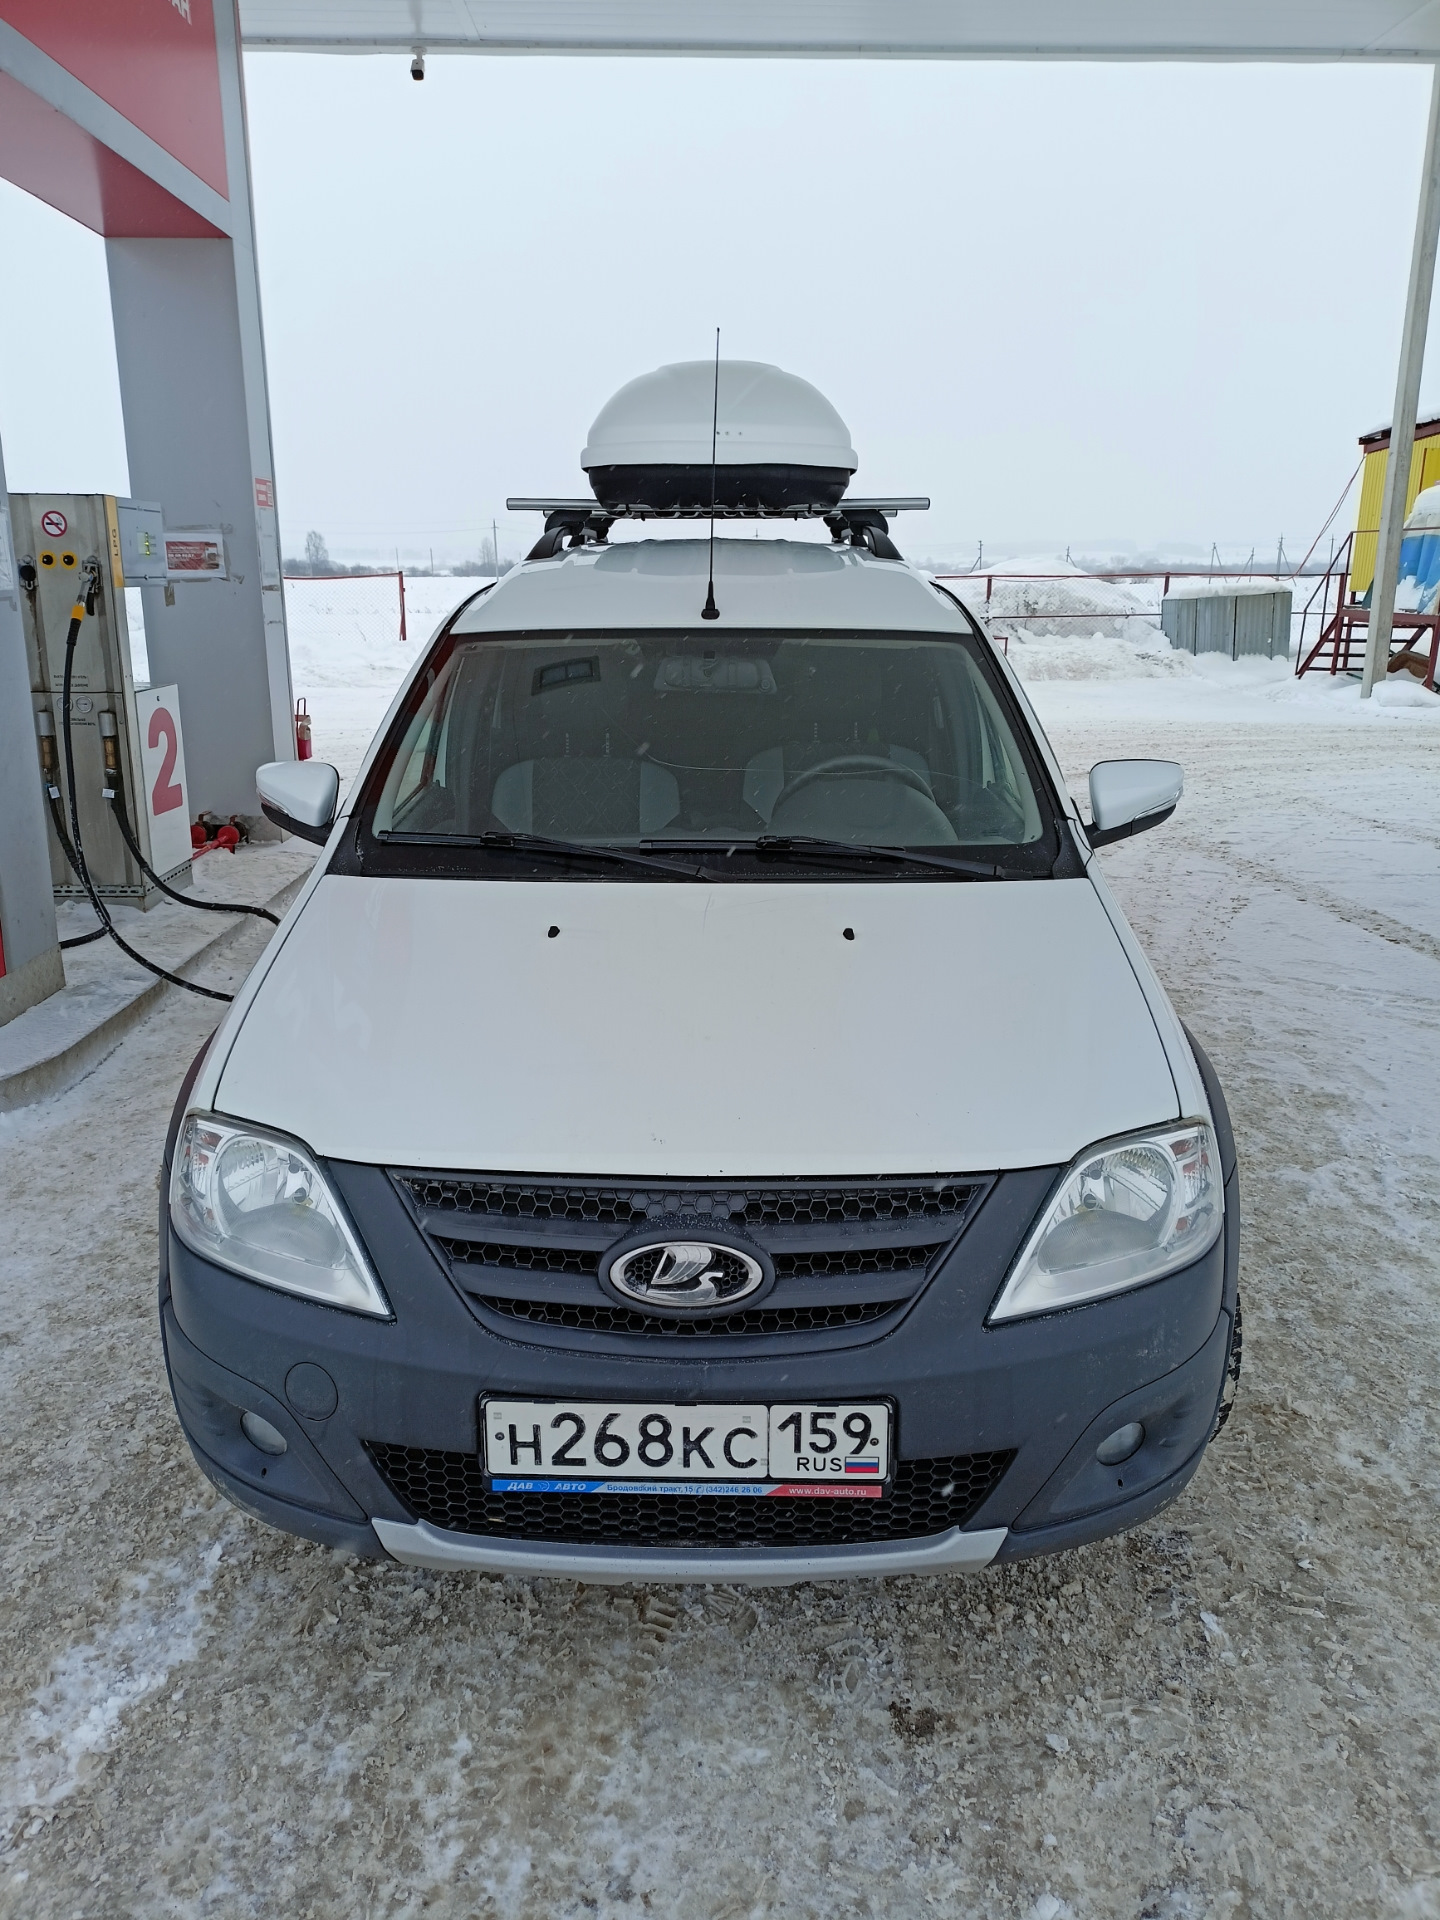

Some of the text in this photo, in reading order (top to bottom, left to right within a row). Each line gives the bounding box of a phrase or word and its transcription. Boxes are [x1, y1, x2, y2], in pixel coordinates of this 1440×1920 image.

[148, 707, 183, 816] 2
[777, 1411, 872, 1455] 159
[796, 1457, 842, 1472] RUS
[507, 1482, 587, 1491] ДАВ АВТО
[607, 1483, 657, 1493] Бродовский
[684, 1485, 694, 1494] 15
[788, 1486, 867, 1496] www.dav-auto.ru
